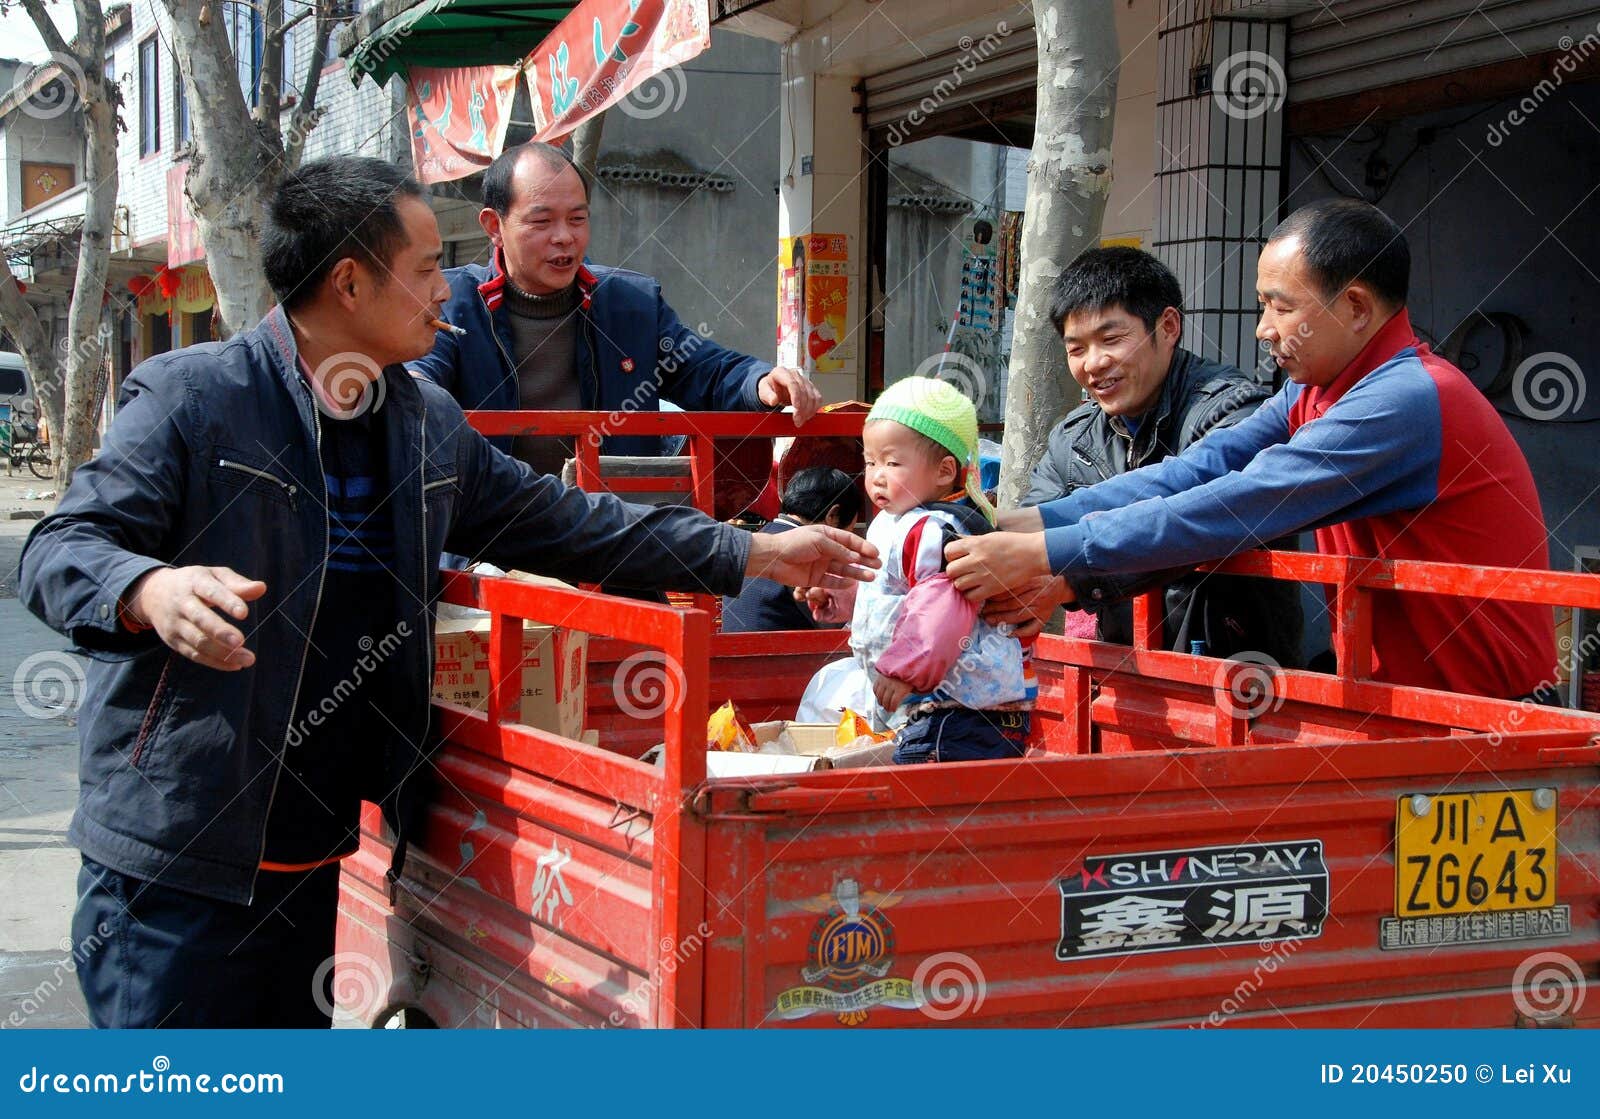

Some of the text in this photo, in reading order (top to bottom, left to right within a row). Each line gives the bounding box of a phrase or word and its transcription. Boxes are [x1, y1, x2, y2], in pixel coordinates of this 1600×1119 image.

[1490, 797, 1526, 844] A
[1110, 847, 1308, 886] SHINERAY
[1406, 847, 1547, 911] ZG643
[1078, 883, 1312, 952] 鑫源
[1385, 906, 1568, 946] 重庆鑫源摩托车制造有限公司
